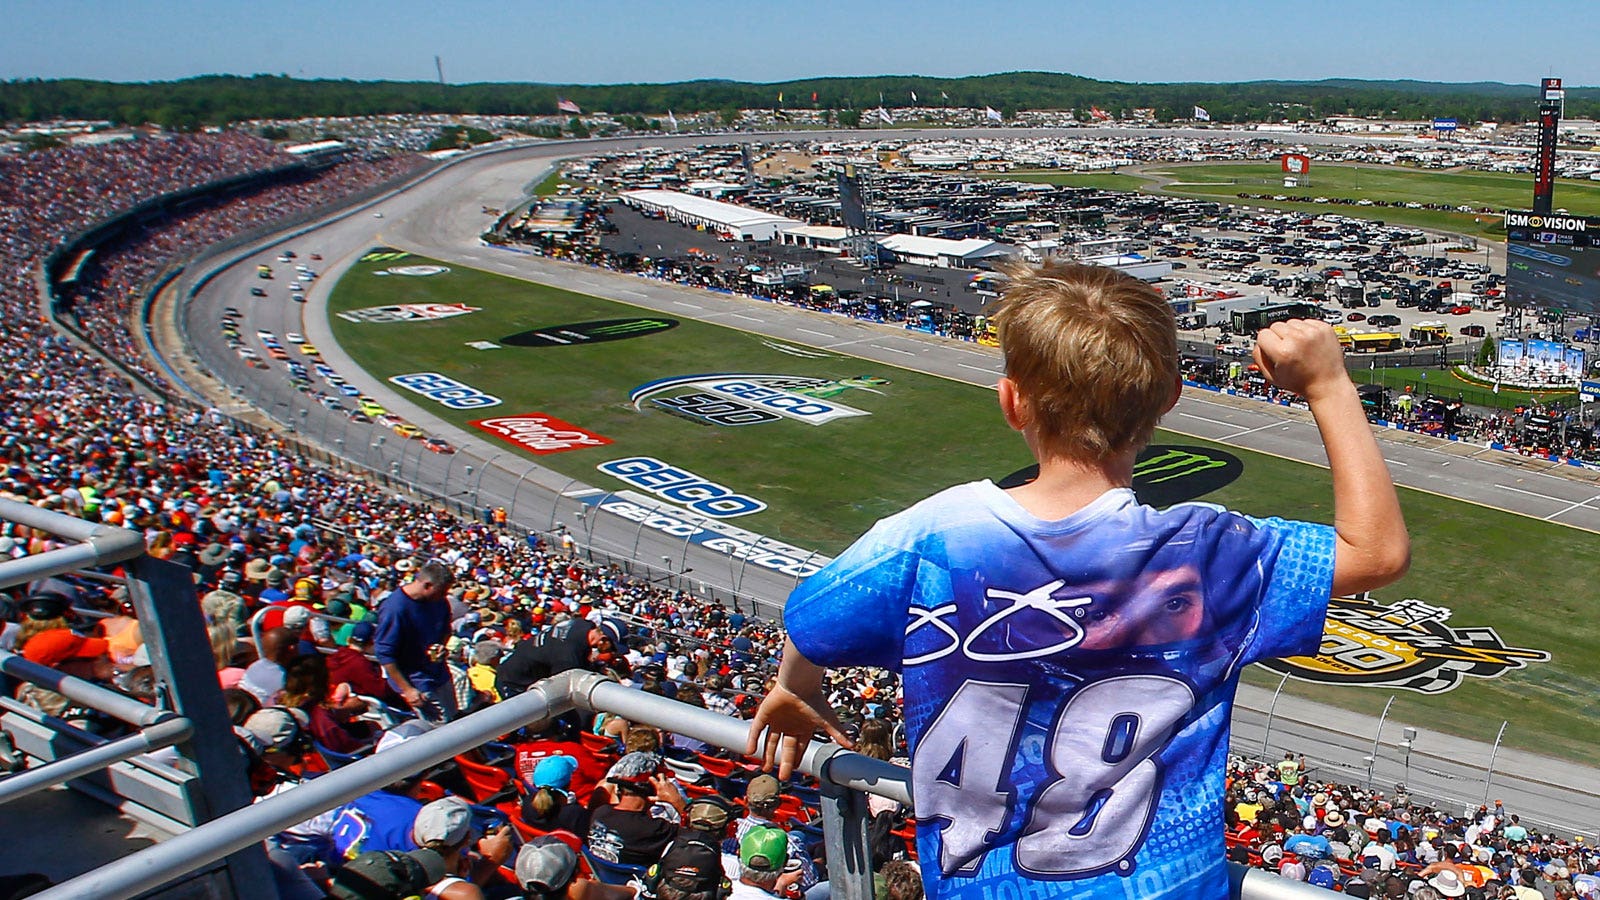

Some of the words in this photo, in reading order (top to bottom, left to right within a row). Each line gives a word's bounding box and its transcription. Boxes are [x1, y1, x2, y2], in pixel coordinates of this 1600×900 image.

[1507, 214, 1528, 227] ISM
[1543, 216, 1586, 231] VISION
[396, 374, 496, 407] GEICO
[713, 382, 834, 415] GEICO
[653, 392, 784, 426] 500
[600, 457, 766, 518] GEICO
[600, 501, 704, 536] GEICO
[701, 537, 825, 577] GEICO
[1319, 633, 1404, 670] 00
[912, 676, 1197, 873] 48
